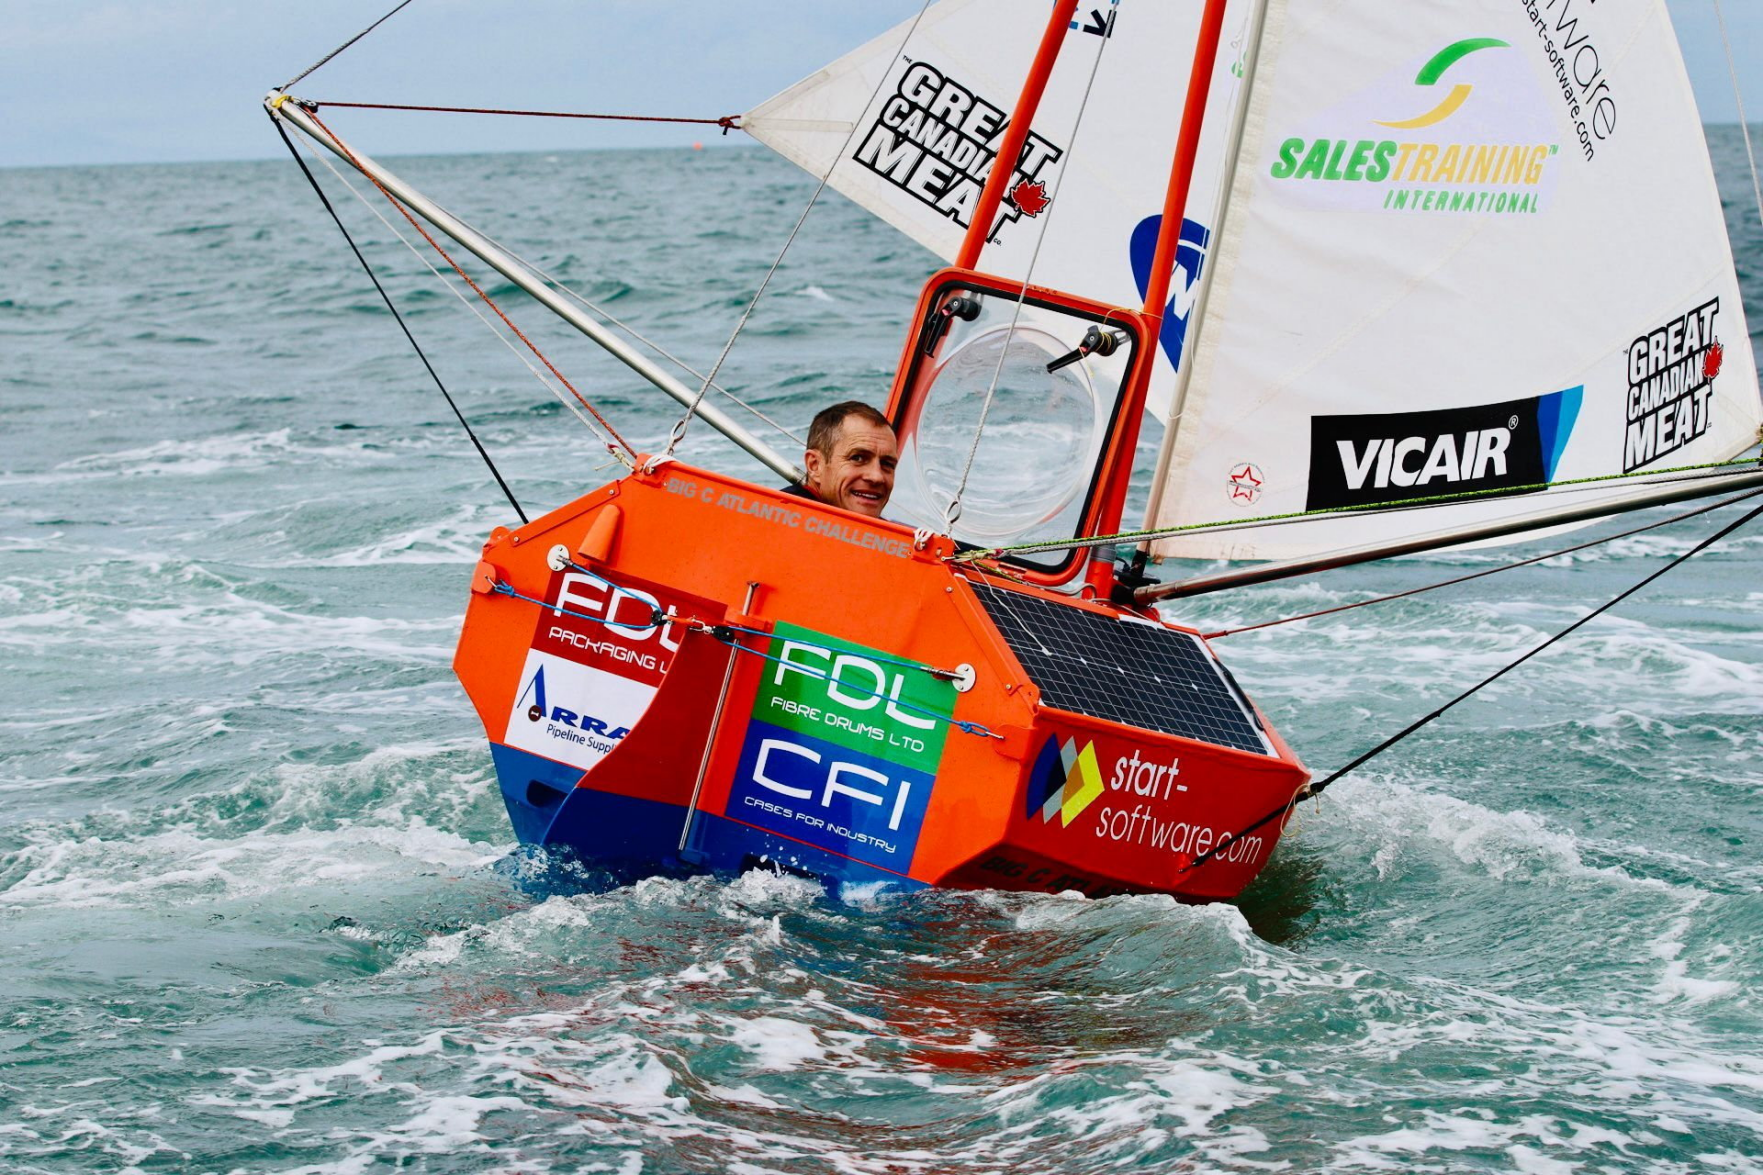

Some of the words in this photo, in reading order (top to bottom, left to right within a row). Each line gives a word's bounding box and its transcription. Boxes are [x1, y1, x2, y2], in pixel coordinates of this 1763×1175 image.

[897, 61, 1064, 177] GRET
[1383, 190, 1538, 213] INTERNATIONAL
[1628, 296, 1719, 386] GREAT
[1626, 349, 1706, 424] CANADIAN
[1623, 383, 1712, 473] MEAT
[667, 477, 696, 498] BIG
[701, 487, 714, 502] C
[717, 494, 802, 528] ATLANTIC
[805, 517, 911, 559] CHALLENGE
[549, 626, 656, 670] PACKAGING
[554, 572, 679, 653] FDL
[774, 640, 936, 730] FDL
[546, 723, 585, 745] Pipeline
[771, 696, 821, 721] FIBRE
[824, 712, 884, 741] DRUMS
[889, 733, 924, 753] LTD
[752, 738, 911, 831] CFI
[1110, 749, 1188, 800] start-
[744, 796, 792, 818] CASES
[795, 813, 824, 829] FOR
[827, 823, 896, 853] INDUSTRY
[1096, 804, 1262, 864] softwarecom
